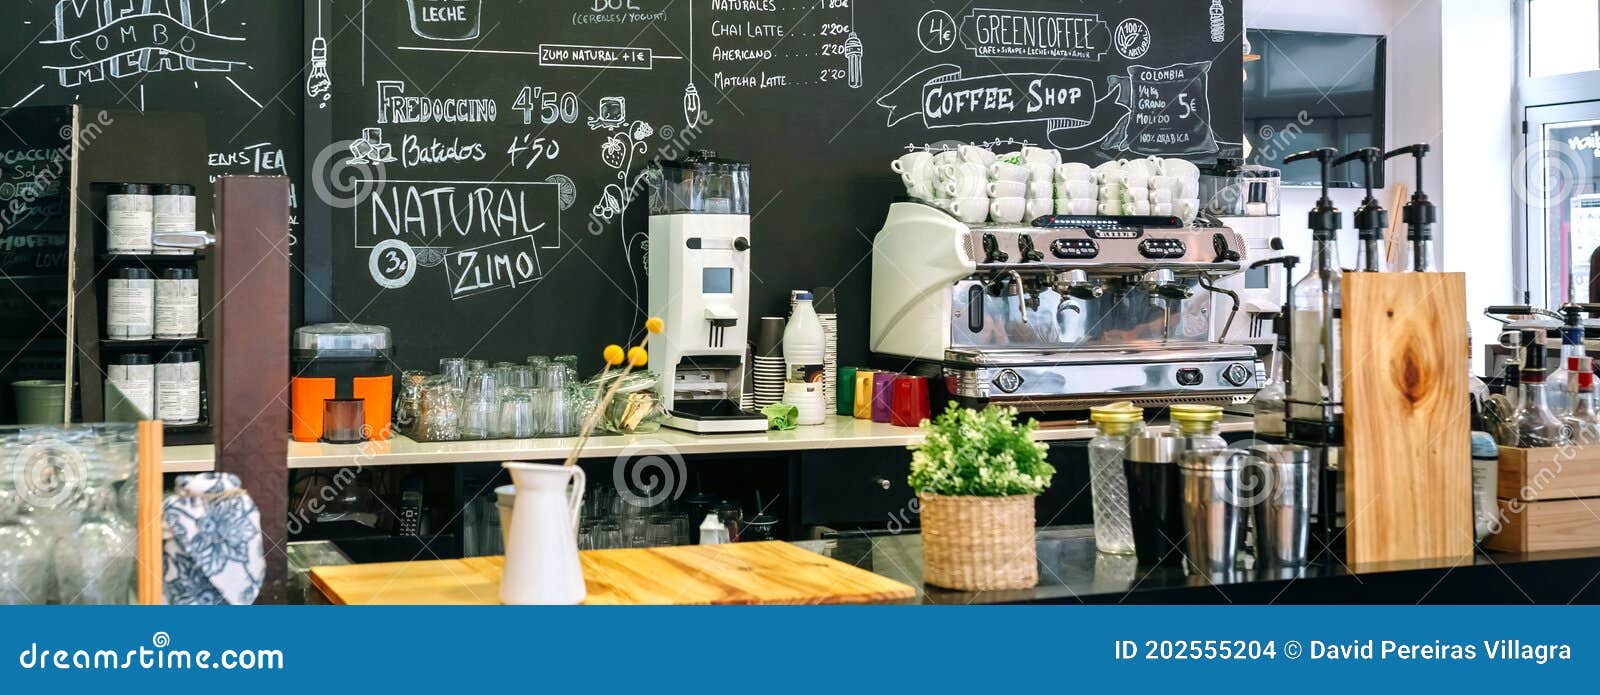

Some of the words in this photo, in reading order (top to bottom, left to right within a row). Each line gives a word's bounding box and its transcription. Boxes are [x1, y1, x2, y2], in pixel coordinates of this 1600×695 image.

[422, 6, 467, 22] LECHE
[712, 21, 743, 37] CHAI
[748, 21, 784, 38] LATTE
[70, 23, 195, 59] COMBO
[1128, 30, 1149, 57] NATURAL
[542, 49, 568, 61] ZUMO
[573, 50, 618, 62] NATURAL
[712, 47, 772, 61] AMERICANO
[714, 72, 756, 90] MATCHA
[761, 72, 787, 88] LATTE
[1140, 70, 1184, 81] COLOMBIA
[377, 81, 498, 125] FREDOCCINO
[512, 87, 579, 125] 4'50
[926, 84, 1015, 118] COFFEE
[1027, 79, 1081, 113] SHOP
[1138, 99, 1166, 110] GRANO
[1136, 113, 1170, 125] MOLIDO
[1157, 133, 1189, 145] ARABICA
[244, 142, 288, 176] TEA
[402, 134, 486, 168] Batidos
[507, 133, 560, 170] 4'50
[372, 186, 546, 237] NATURAL
[453, 250, 534, 294] ZUMO
